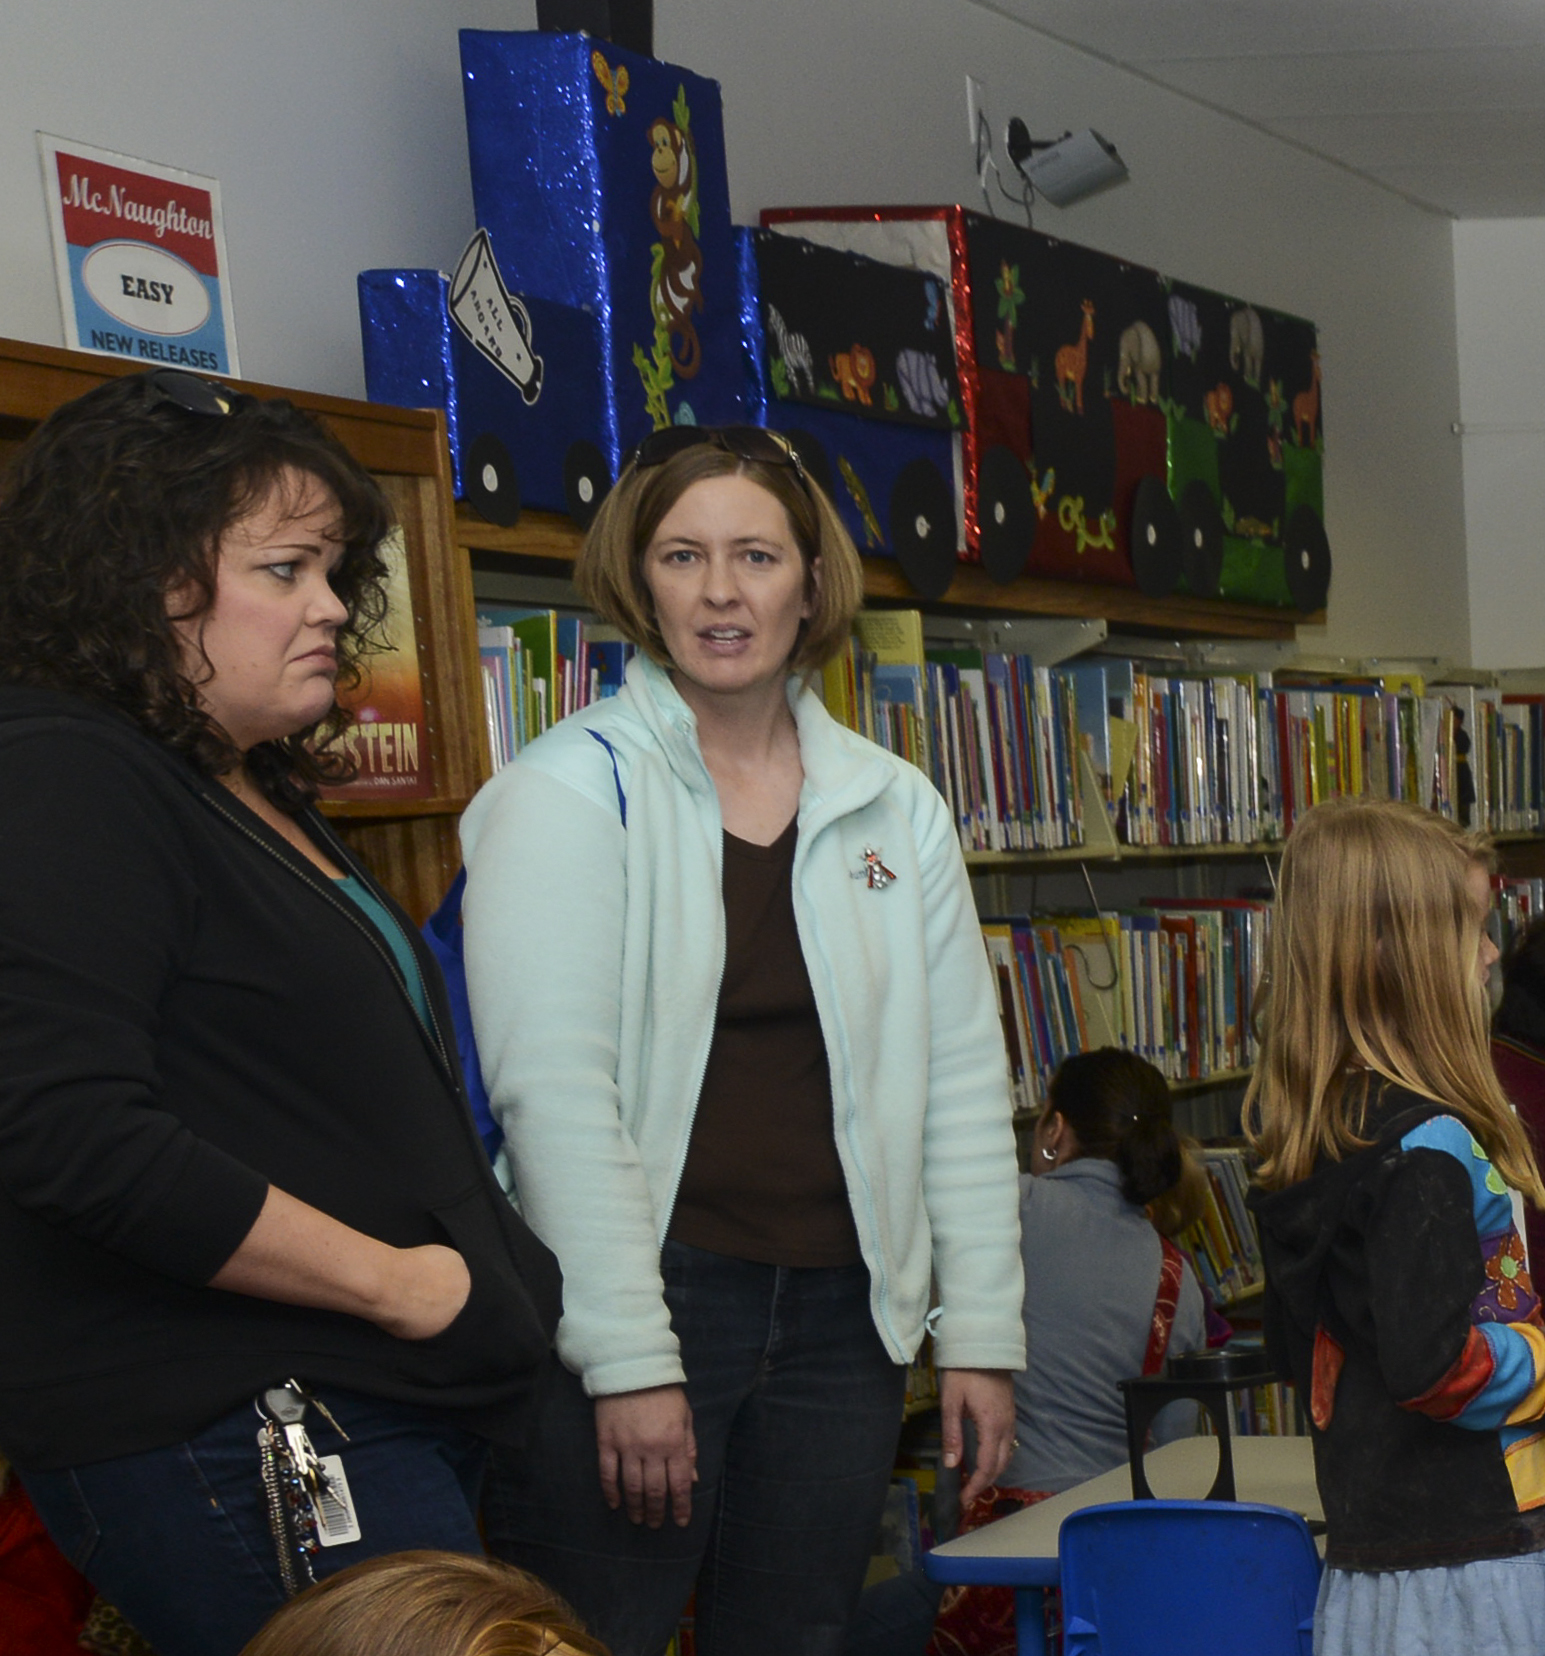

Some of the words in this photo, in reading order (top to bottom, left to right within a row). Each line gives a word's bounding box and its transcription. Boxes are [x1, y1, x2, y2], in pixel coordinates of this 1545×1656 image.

[62, 174, 214, 239] McNaughton
[121, 274, 174, 305] EASY
[470, 290, 503, 358] ABOARD
[486, 298, 503, 332] ALL
[91, 329, 134, 355] NEW
[138, 339, 218, 371] RELEASES
